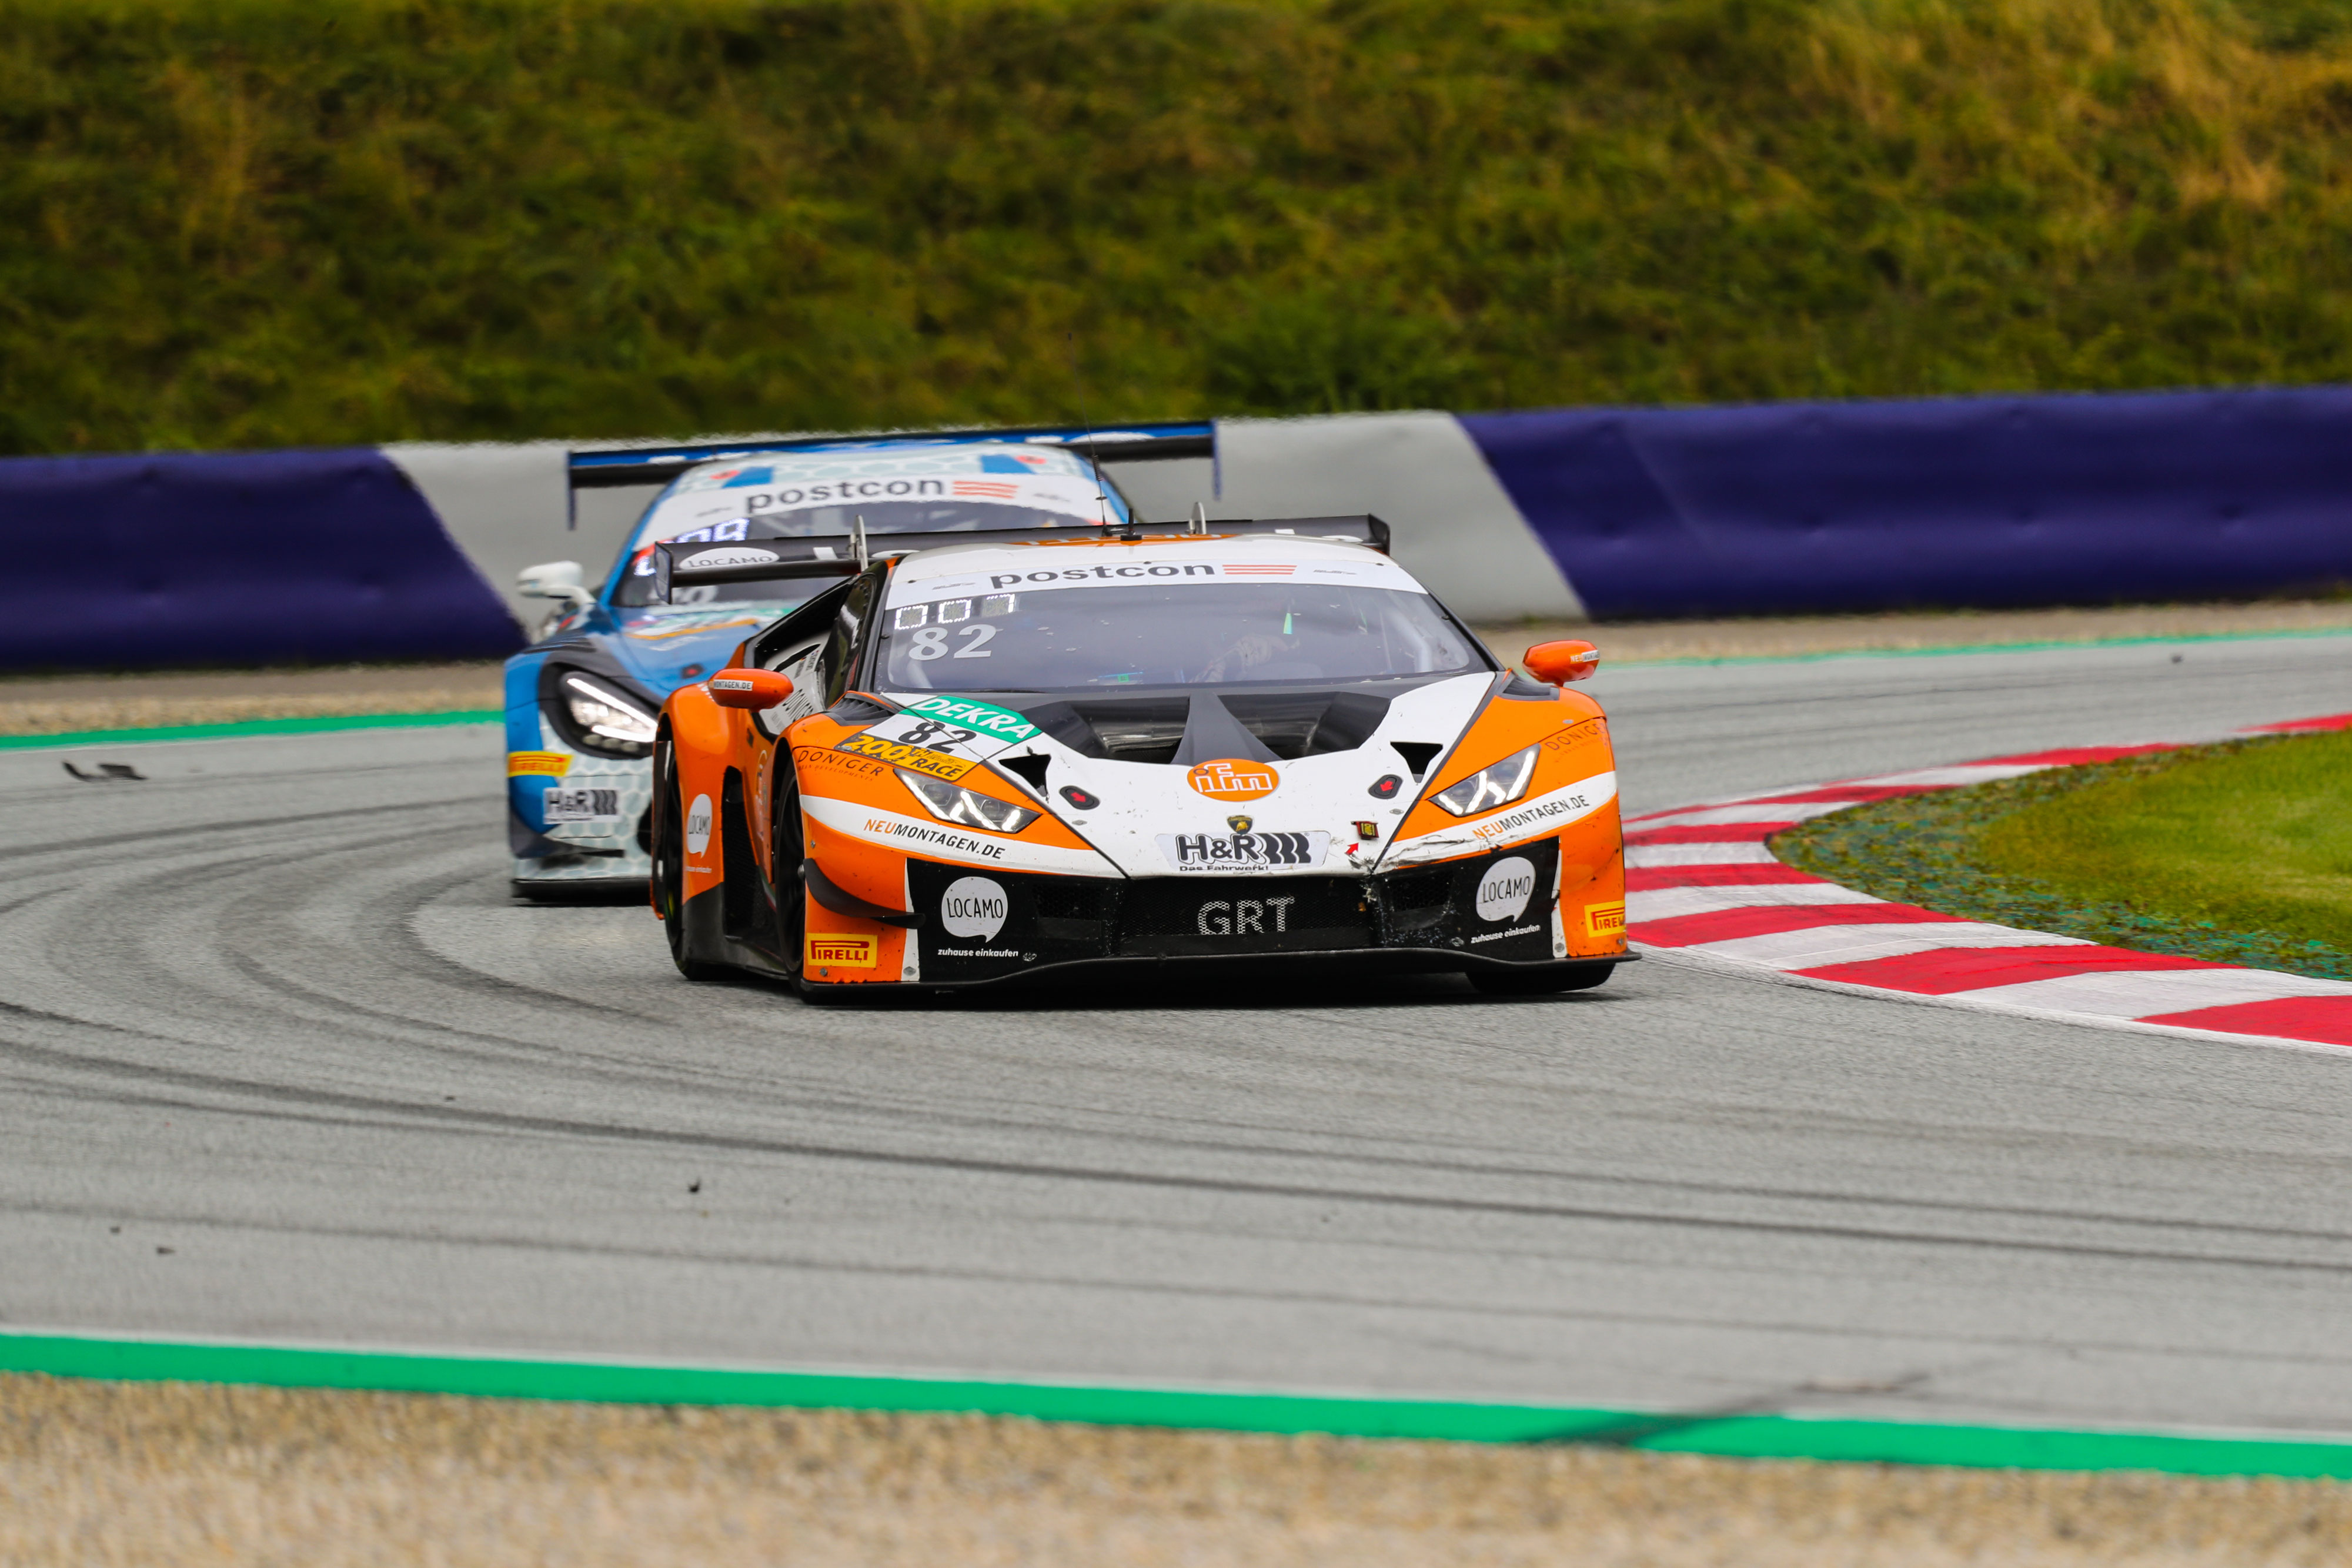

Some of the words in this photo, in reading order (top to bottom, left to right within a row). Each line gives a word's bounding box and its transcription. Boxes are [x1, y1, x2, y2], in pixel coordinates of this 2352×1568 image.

[746, 479, 943, 514] postcon
[688, 556, 772, 567] LOCAMO
[990, 564, 1215, 589] postcon
[908, 624, 997, 661] 82
[912, 698, 1035, 740] DEKRA
[898, 721, 977, 754] 82
[798, 750, 884, 776] DONIGER
[910, 758, 963, 777] RACE
[1193, 763, 1274, 793] ifm
[1472, 795, 1590, 840] NEUMONTAGEN.DE
[863, 819, 1005, 859] NEUMONTAGEN.DE
[1177, 834, 1264, 864] H&R
[1483, 876, 1531, 902] LOCAMO
[947, 897, 1004, 918] LOCAMO
[1198, 897, 1295, 935] GRT
[1591, 907, 1625, 931] PIREL
[1471, 932, 1504, 944] zuhause
[1504, 924, 1541, 938] einkaufen
[811, 941, 870, 961] PIRELLI
[938, 948, 974, 957] zuhause
[975, 948, 1019, 957] einkaufen
